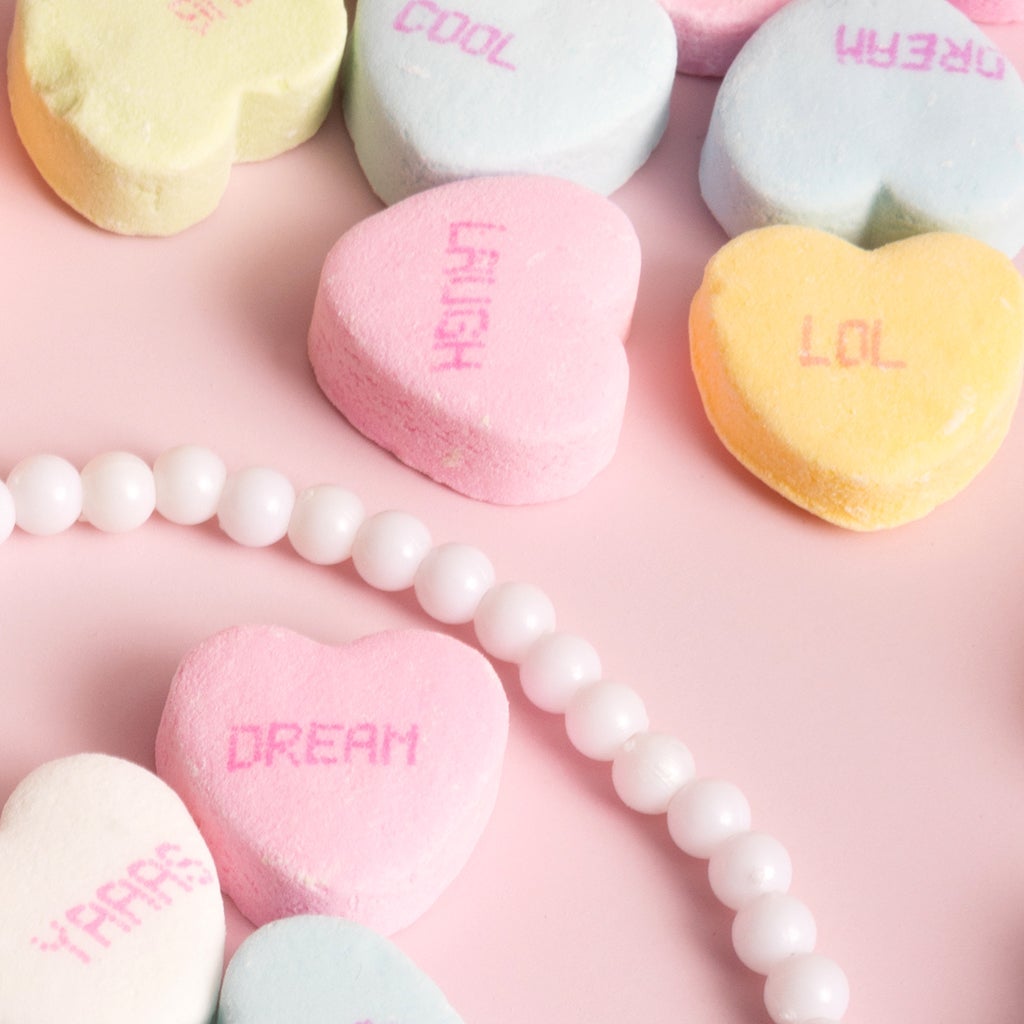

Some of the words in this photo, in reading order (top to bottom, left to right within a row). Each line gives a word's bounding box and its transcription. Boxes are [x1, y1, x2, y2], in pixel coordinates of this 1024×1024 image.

[393, 0, 517, 72] COOL
[834, 24, 1006, 80] DREAM
[431, 219, 507, 373] LAUGH
[799, 314, 906, 369] LOL
[227, 722, 420, 772] DREAM
[30, 841, 213, 963] YAAAS
